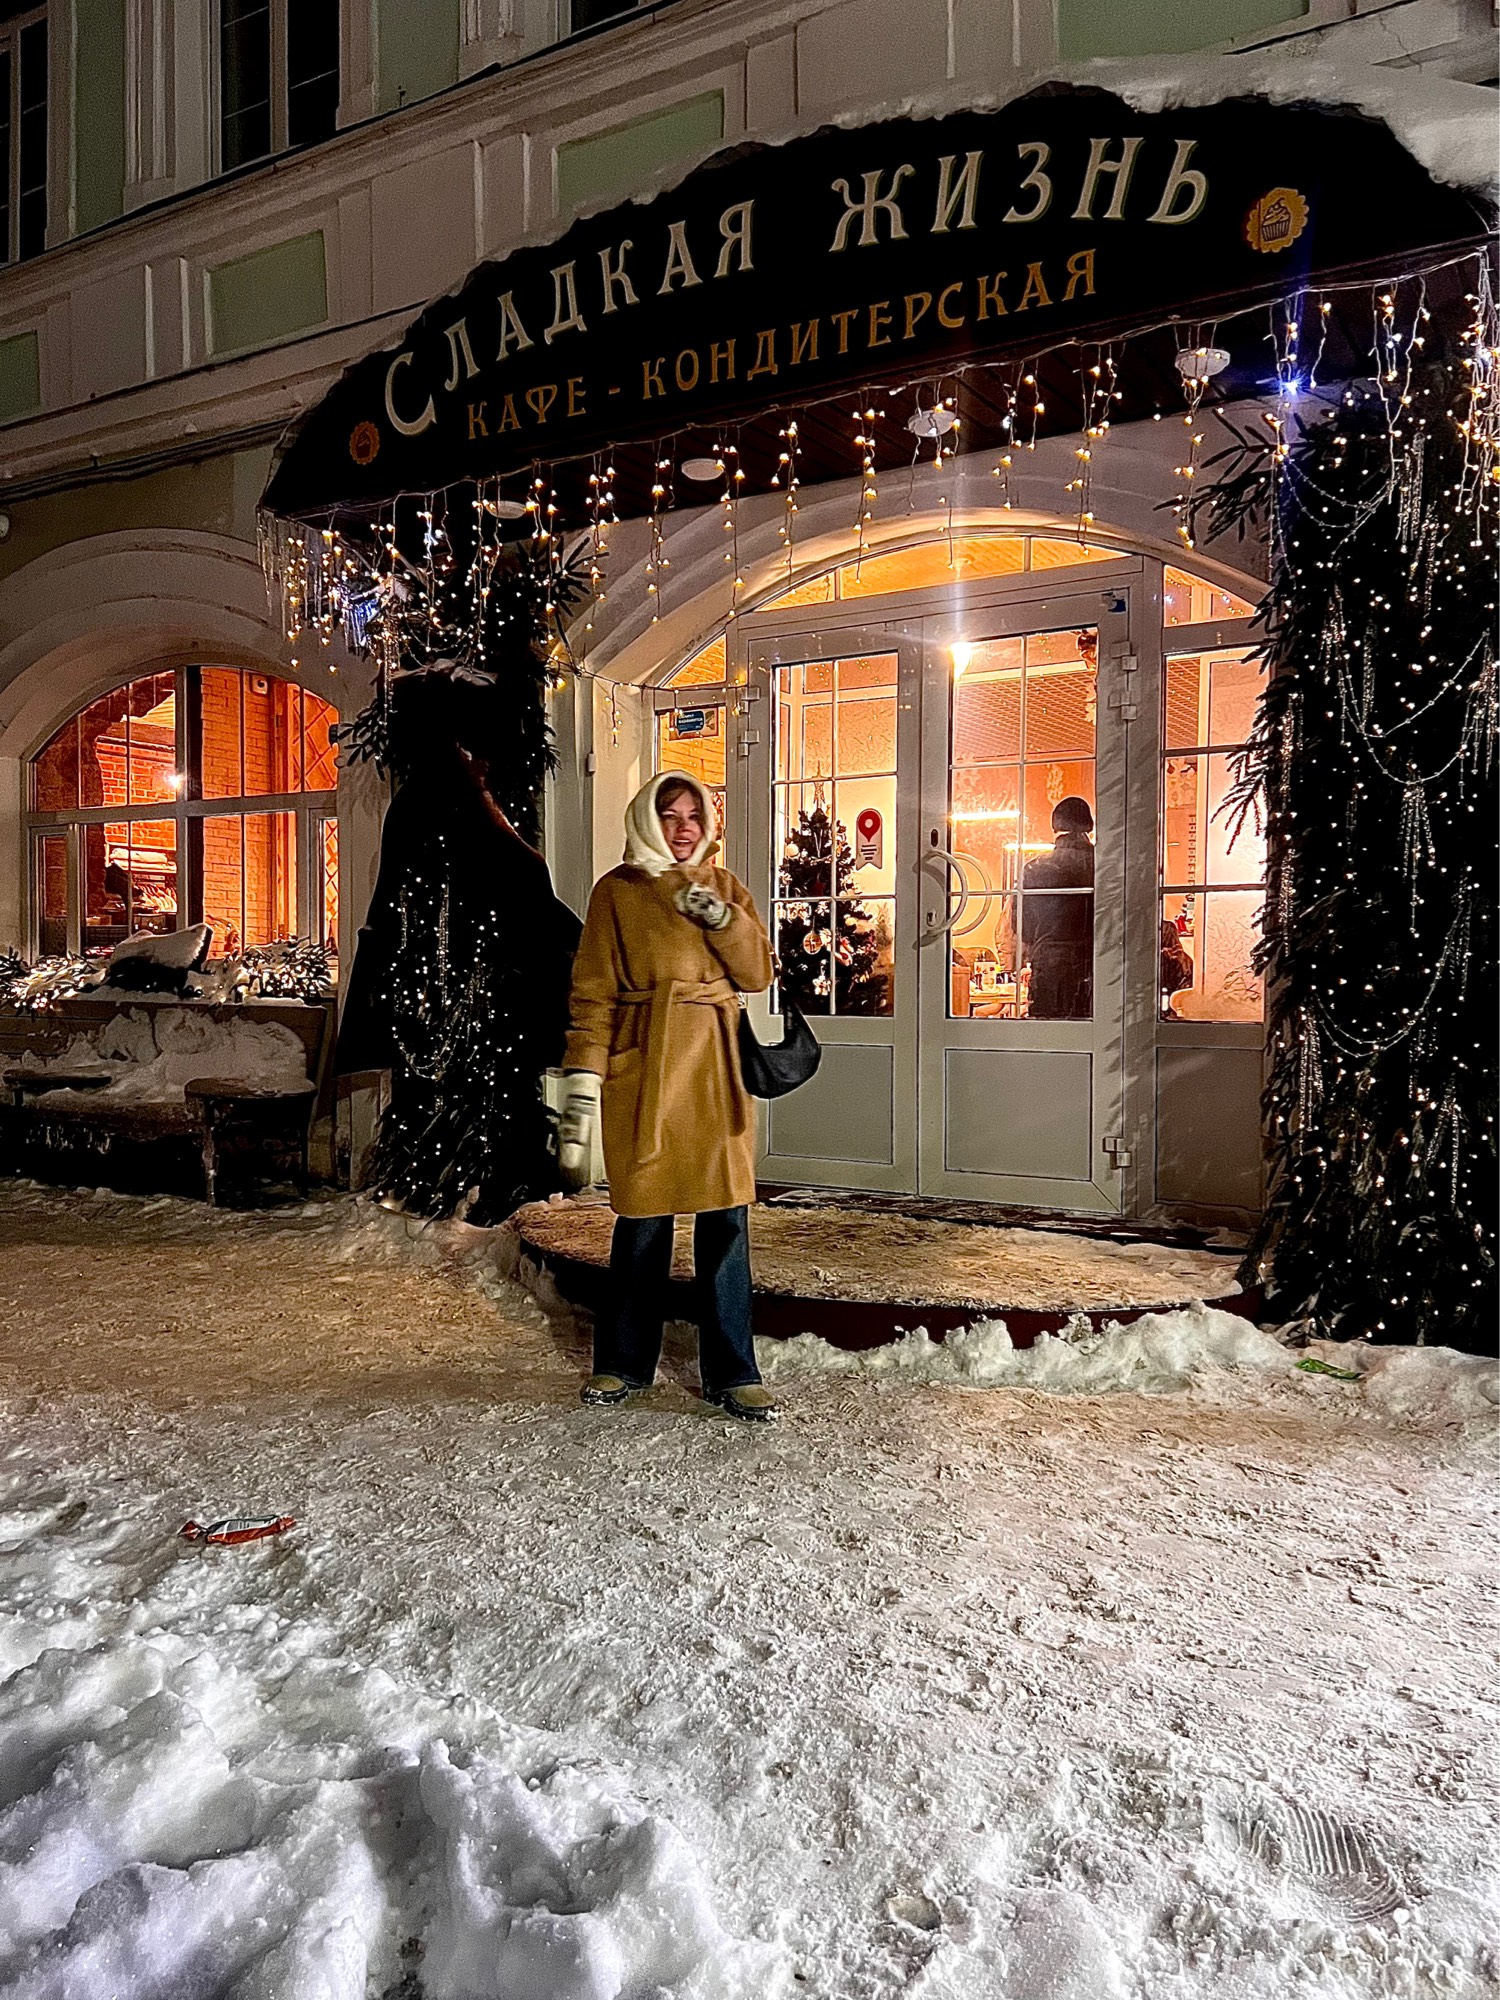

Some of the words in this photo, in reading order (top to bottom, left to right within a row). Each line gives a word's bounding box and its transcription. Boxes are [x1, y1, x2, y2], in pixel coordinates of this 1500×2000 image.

[385, 199, 755, 436] СЛАДКАЯ
[830, 137, 1208, 251] ЖИЗНЬ
[468, 376, 587, 439] КАФЕ
[643, 250, 1096, 399] КОНДИТЕРСКАЯ
